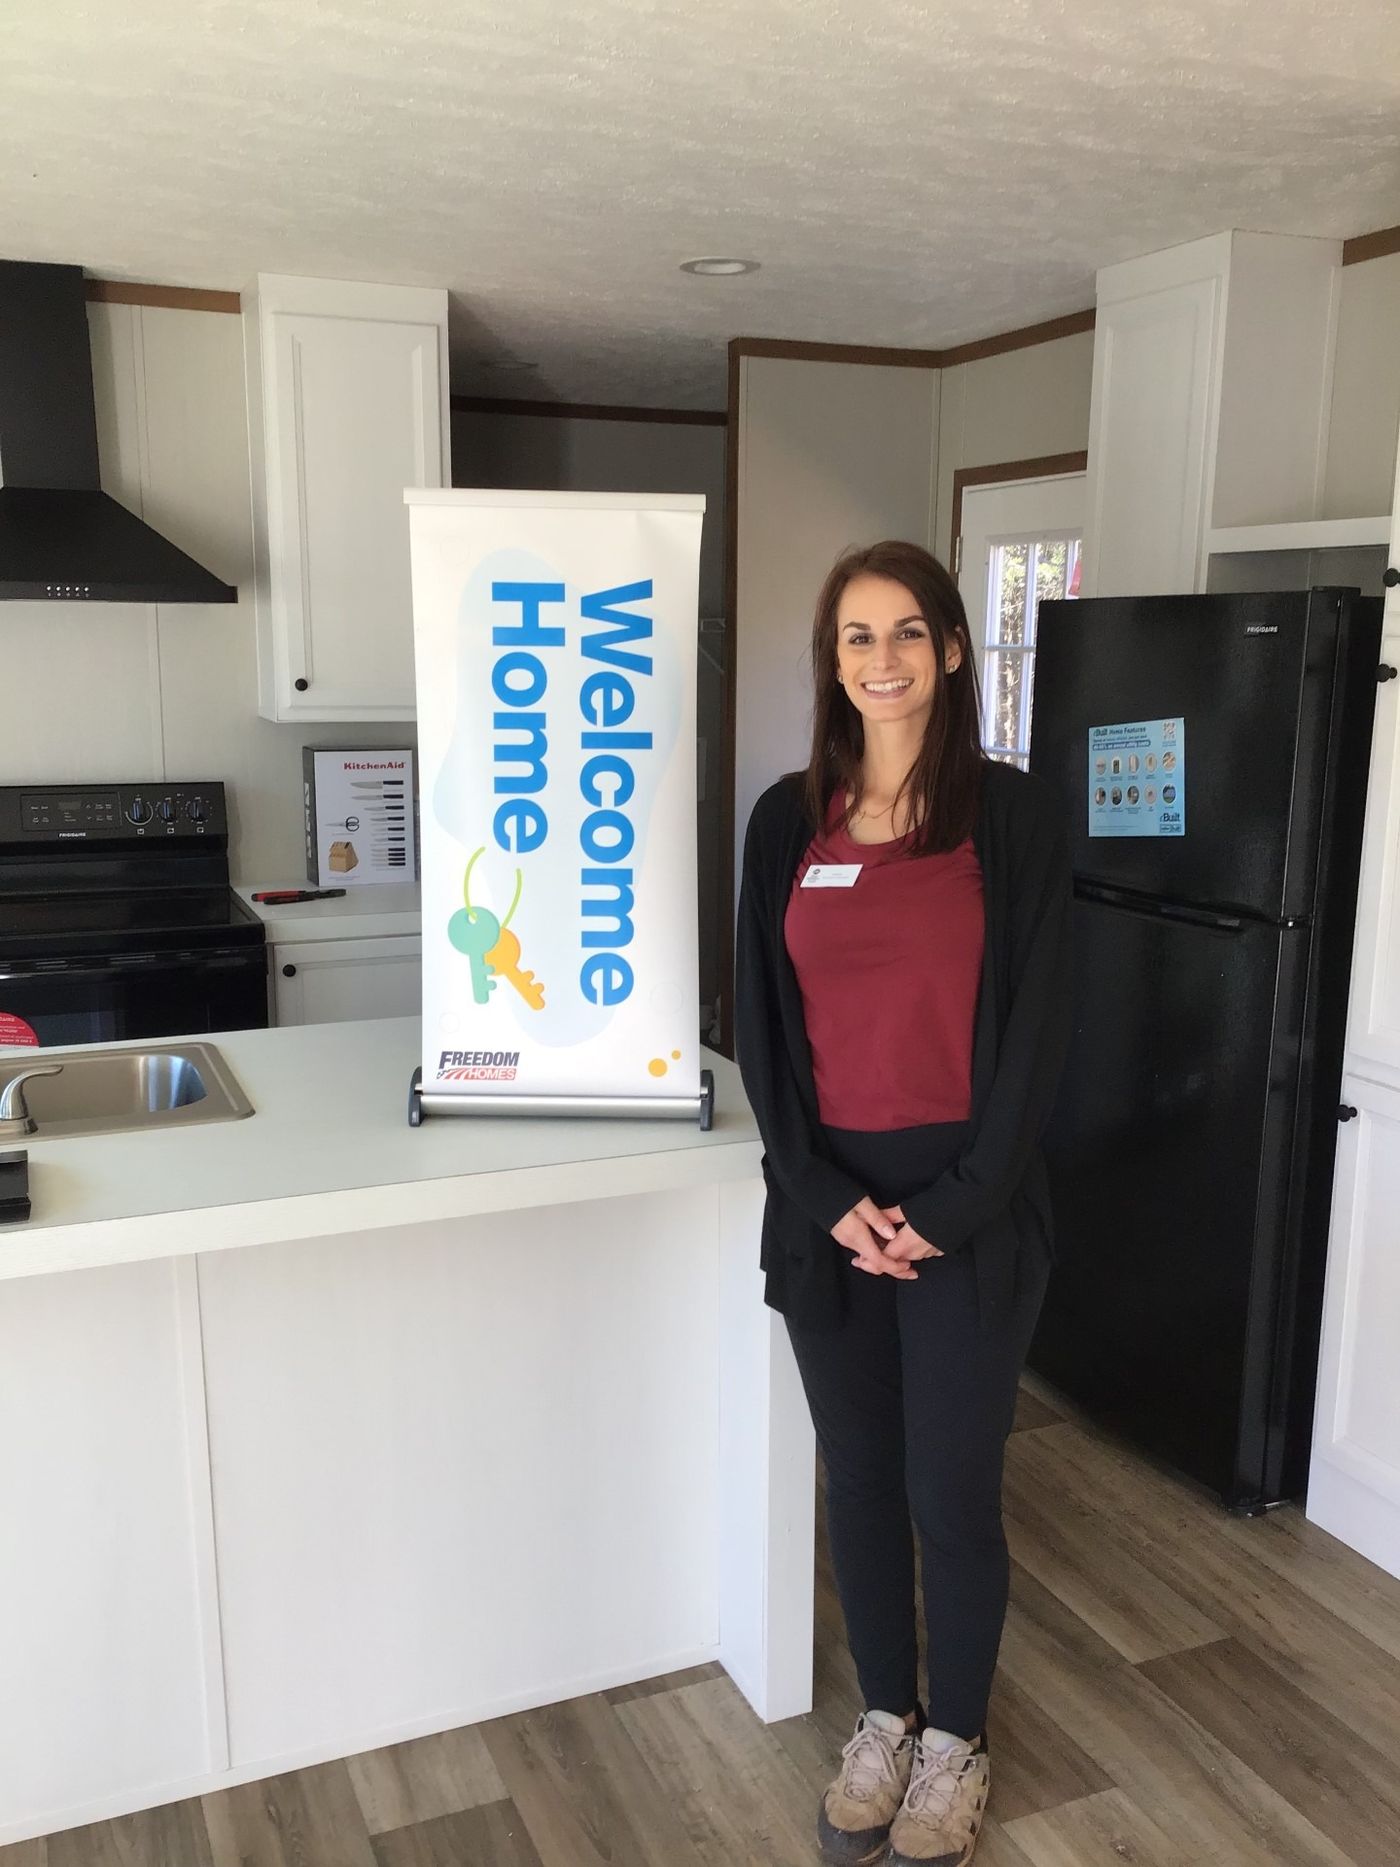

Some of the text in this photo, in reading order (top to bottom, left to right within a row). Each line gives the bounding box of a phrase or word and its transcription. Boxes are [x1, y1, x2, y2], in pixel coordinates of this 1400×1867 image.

[1246, 625, 1278, 633] FRIGIDAIRE
[491, 581, 566, 854] Home
[343, 761, 405, 770] KitchenAid
[580, 578, 654, 1007] Welcome
[439, 1051, 520, 1069] FREEDOM
[467, 1067, 516, 1080] HOMES
